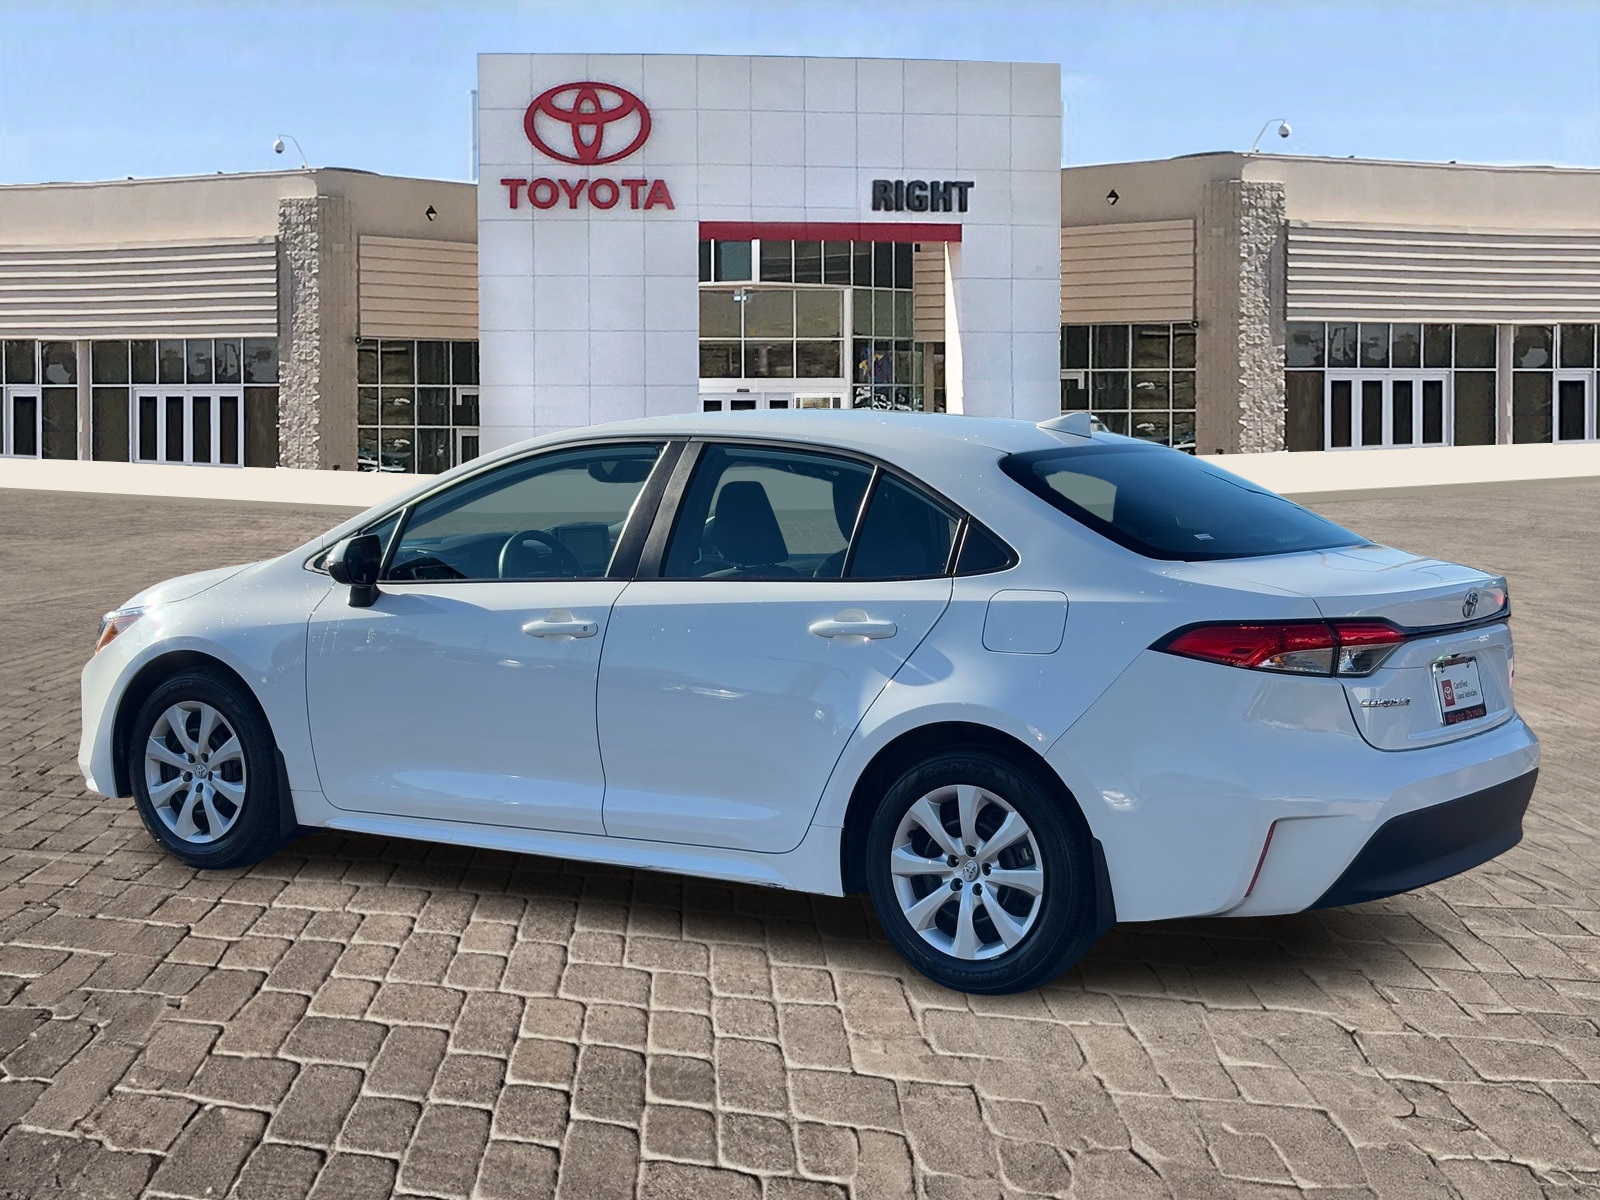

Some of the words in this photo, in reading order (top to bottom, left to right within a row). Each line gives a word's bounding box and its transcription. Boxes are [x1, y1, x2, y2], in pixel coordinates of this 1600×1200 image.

[500, 178, 675, 210] TOYOTA
[872, 179, 975, 212] RIGHT
[1453, 680, 1468, 689] Certified
